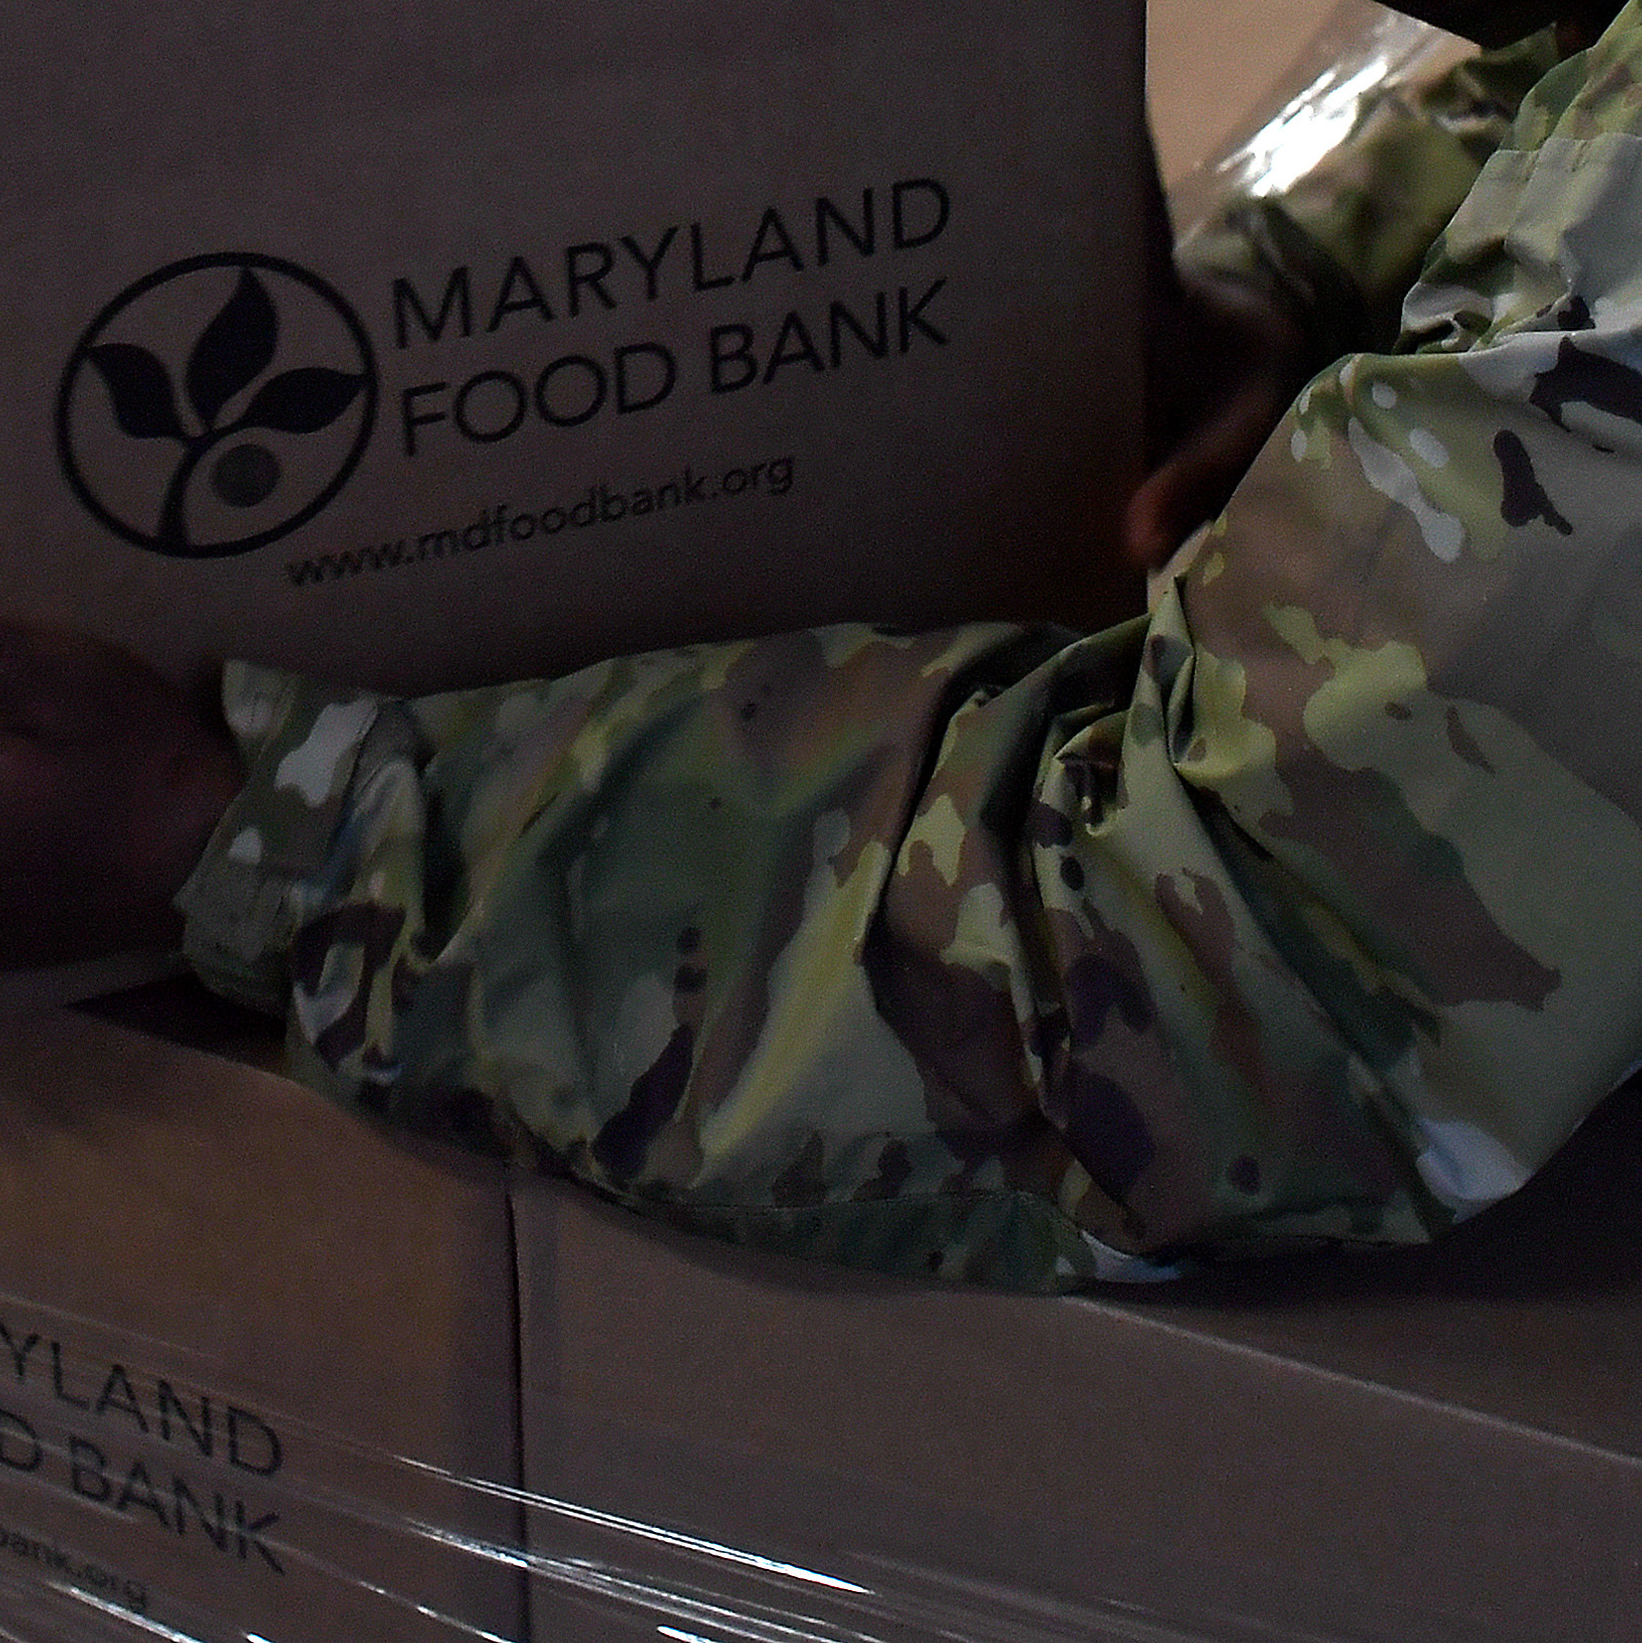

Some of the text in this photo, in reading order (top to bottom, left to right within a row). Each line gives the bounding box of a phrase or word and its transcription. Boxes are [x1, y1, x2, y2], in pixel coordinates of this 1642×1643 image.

[393, 177, 951, 349] MARYLAND
[399, 279, 947, 456] FOOD BANK
[284, 454, 794, 587] www.mdfoodbank.org
[69, 1435, 286, 1576] BANK
